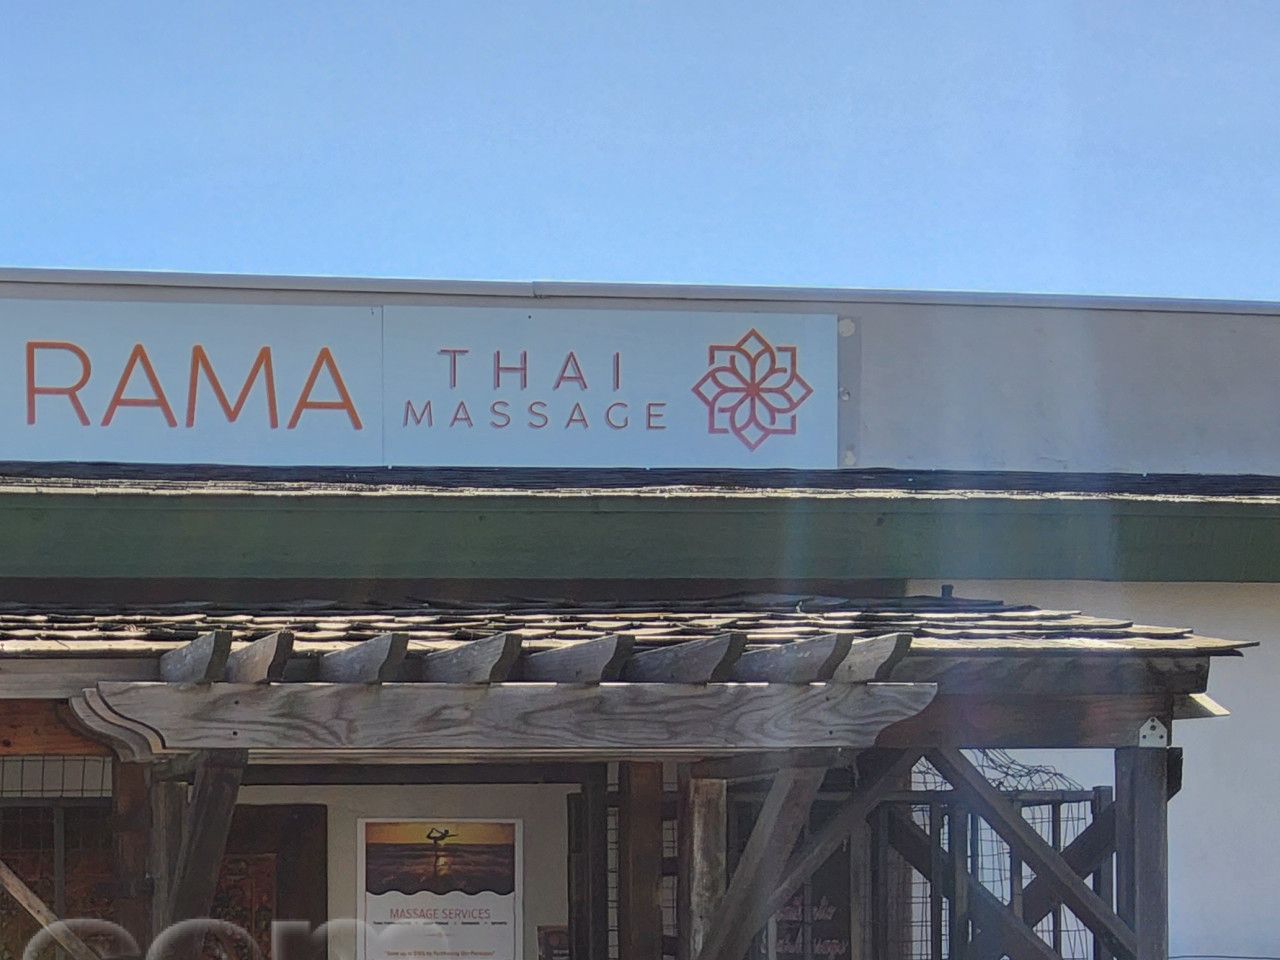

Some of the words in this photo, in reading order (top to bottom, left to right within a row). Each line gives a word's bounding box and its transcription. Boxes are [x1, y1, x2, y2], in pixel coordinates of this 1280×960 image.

[25, 340, 364, 431] RAMA
[437, 348, 620, 391] THAI
[402, 399, 667, 431] MASSAGE
[390, 908, 439, 920] MASSAGE
[442, 908, 491, 920] SERVICES
